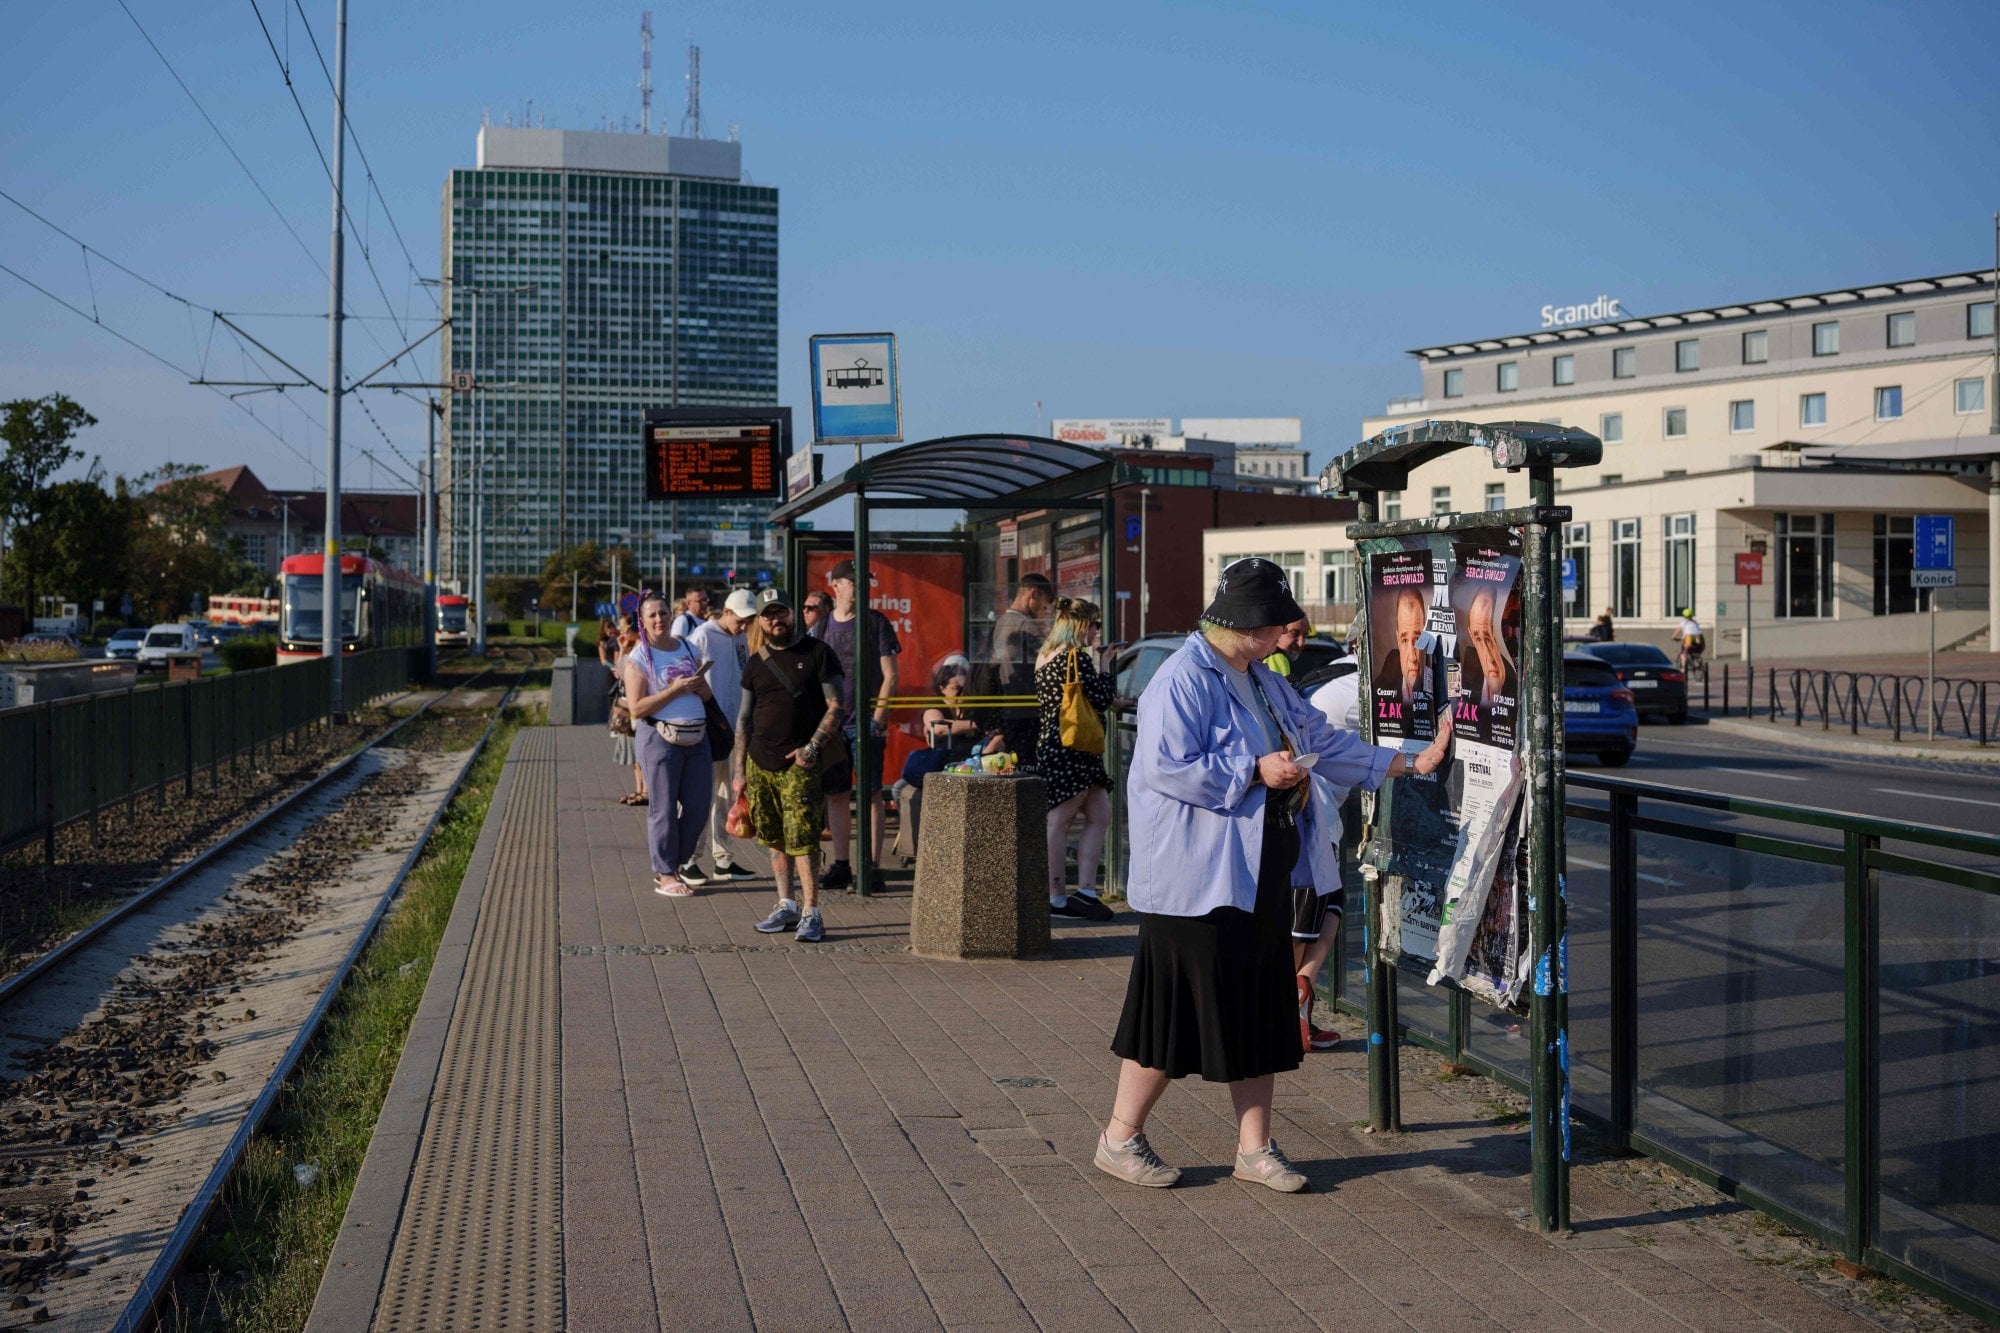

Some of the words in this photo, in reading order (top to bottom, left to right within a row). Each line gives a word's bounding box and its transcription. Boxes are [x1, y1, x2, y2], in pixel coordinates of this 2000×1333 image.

[1541, 295, 1619, 328] Scandic
[459, 376, 467, 387] B
[1383, 574, 1400, 586] SERCA
[1400, 573, 1425, 584] GWIAZD
[1465, 566, 1484, 578] SERCA
[1485, 569, 1506, 582] GWIAZD
[1916, 571, 1953, 584] Koniec
[1377, 688, 1396, 698] Cezary
[1379, 698, 1402, 719] ŻAK
[1456, 697, 1478, 721] ŻAK
